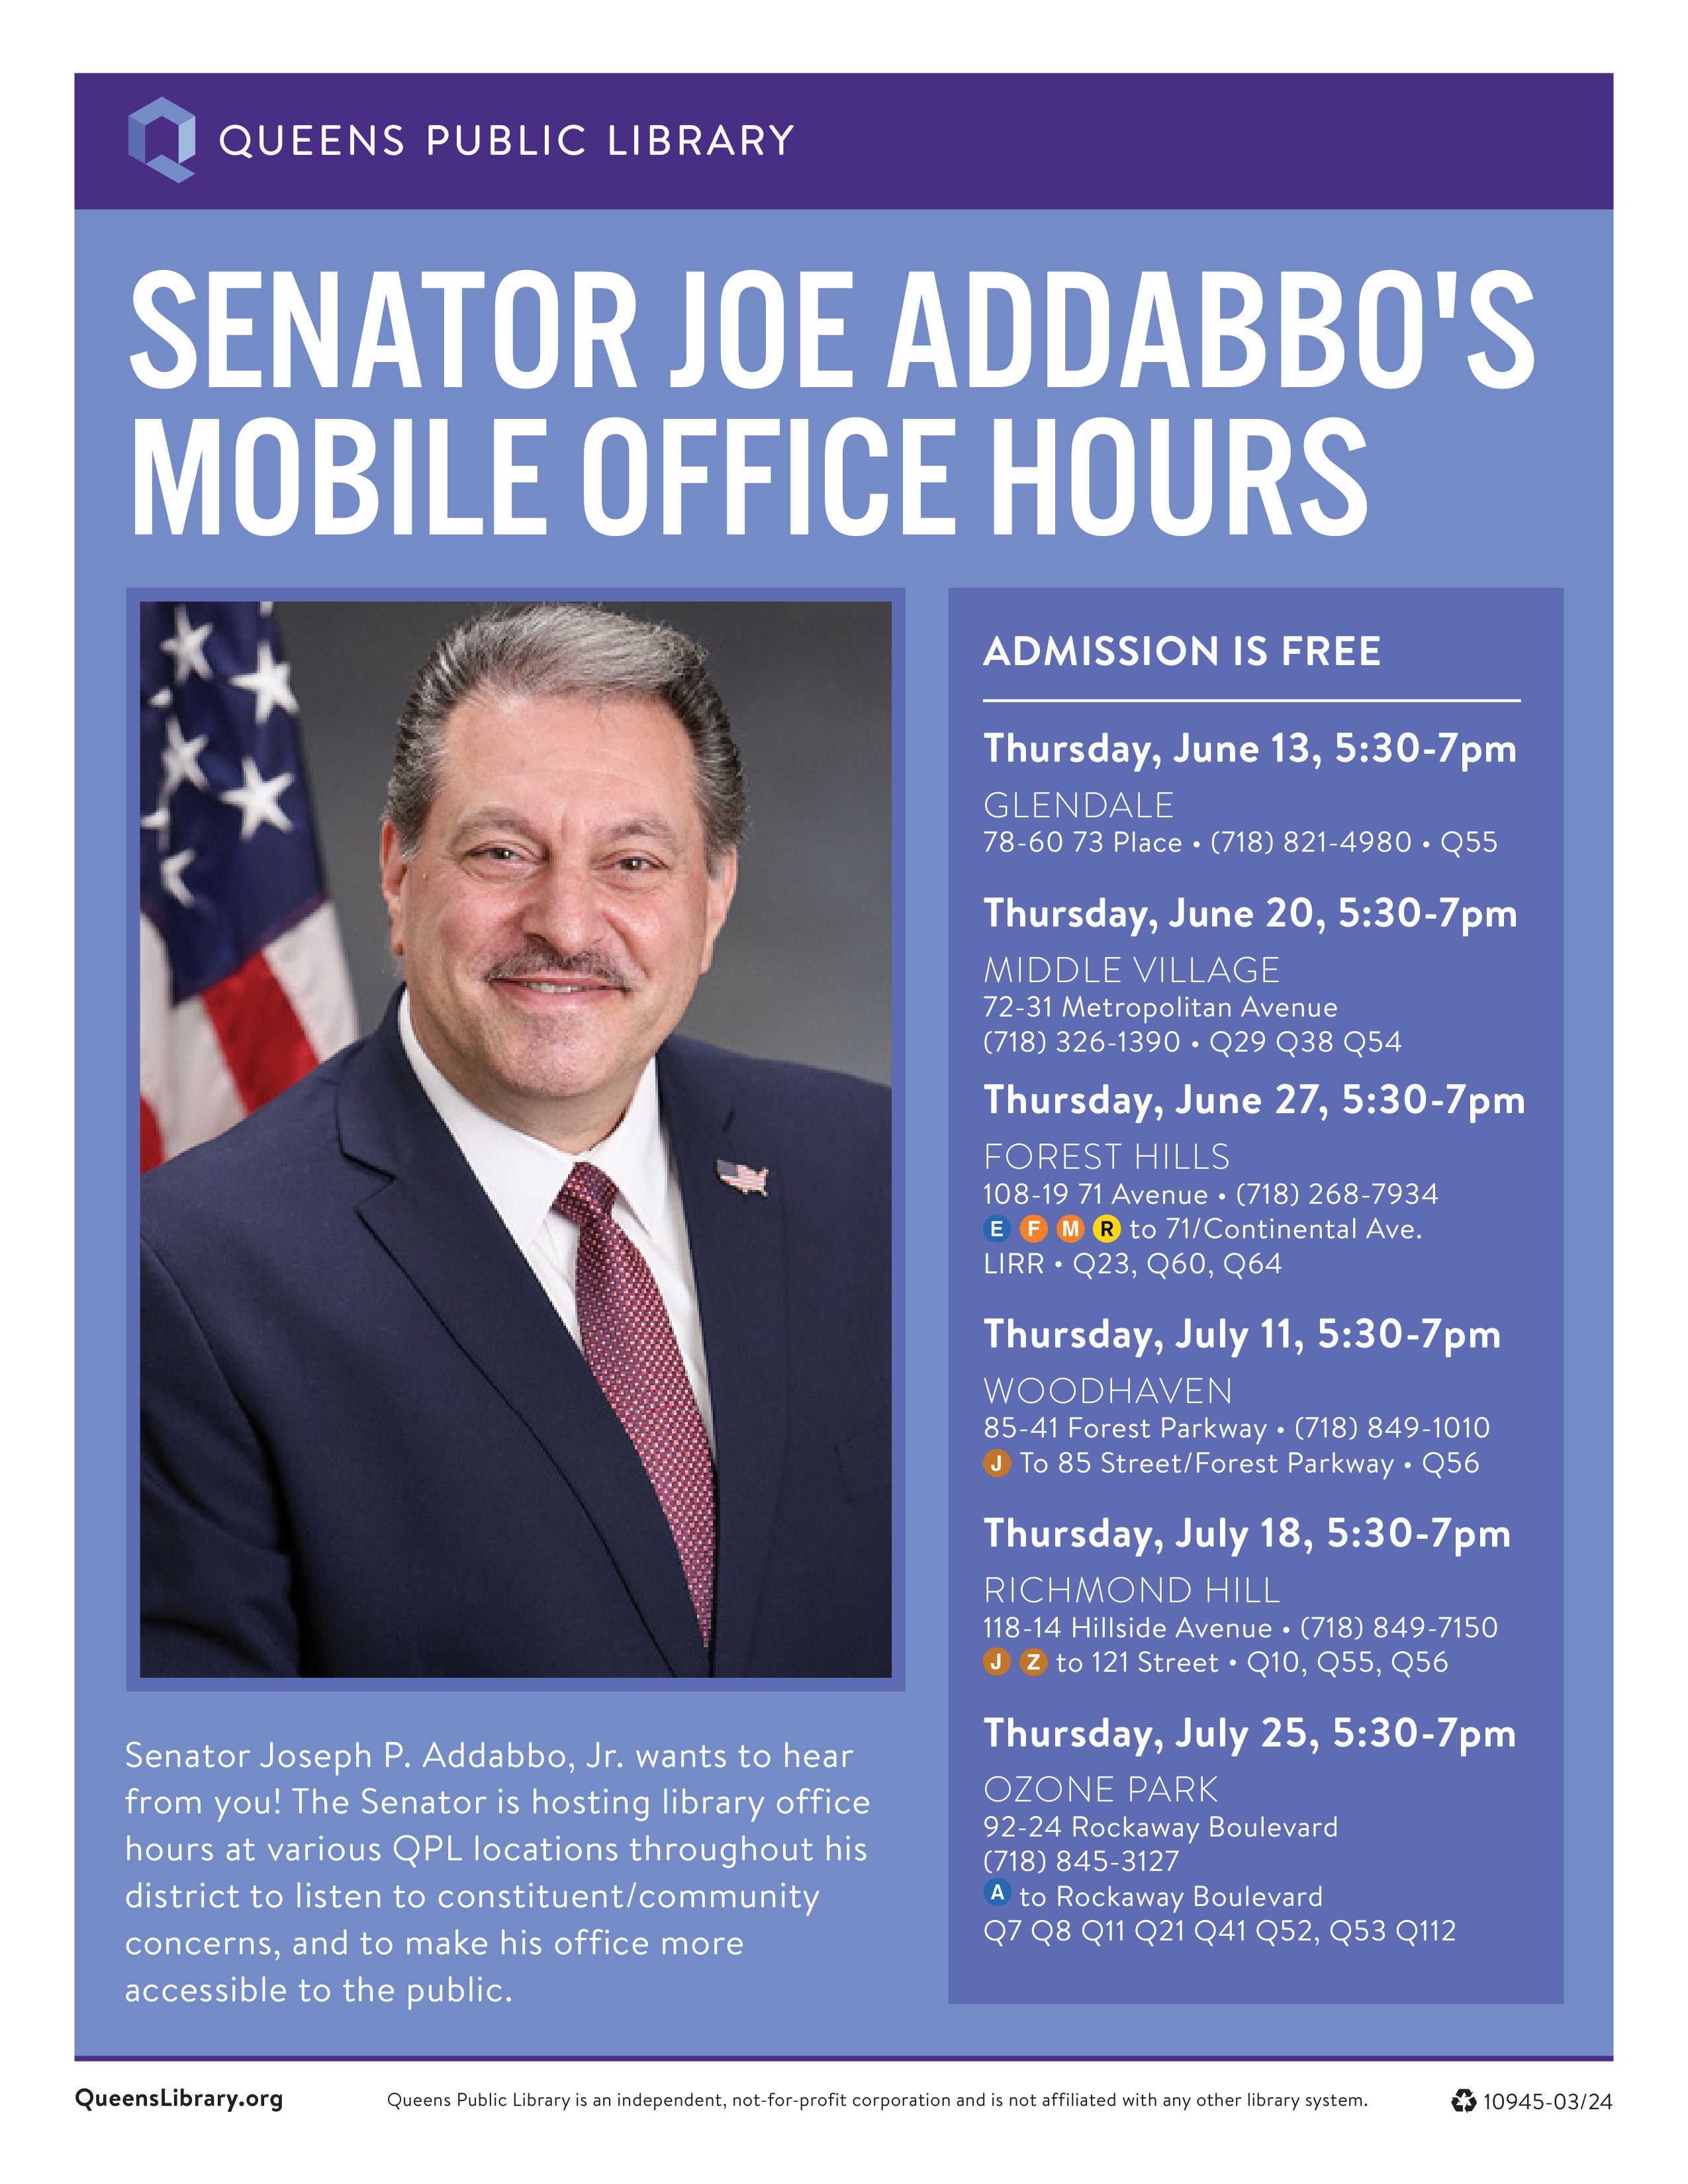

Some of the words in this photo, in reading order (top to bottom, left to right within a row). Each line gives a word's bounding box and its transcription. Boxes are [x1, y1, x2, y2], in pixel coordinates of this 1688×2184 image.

[219, 124, 404, 159] QUEENS
[428, 124, 585, 156] PUBLIC
[609, 124, 794, 156] LIBRARY
[129, 269, 638, 390] SENATOR
[670, 269, 853, 390] JOE
[886, 269, 1535, 390] ADDABBO'S
[134, 416, 547, 537] MOBILE
[583, 416, 956, 537] OFFICE
[993, 416, 1368, 537] HOURS
[982, 635, 1217, 666] ADMISSION
[1235, 635, 1268, 666] IS
[1283, 635, 1380, 666] FREE
[983, 732, 1161, 772] Thursday,
[1173, 732, 1259, 763] June
[1272, 731, 1321, 770] 13,
[1336, 731, 1516, 772] 5:30-7pm
[984, 791, 1174, 819] GLENDALE
[983, 831, 1063, 853] 78-60
[1073, 831, 1103, 853] 73
[1114, 831, 1182, 853] Place
[1211, 831, 1274, 854] (718)
[1284, 831, 1411, 853] 821-4980
[1441, 831, 1497, 858] Q55
[983, 897, 1158, 937] Thursday,
[1168, 897, 1254, 928] June
[1266, 897, 1325, 935] 20,
[1339, 896, 1517, 937] 5:30-7pm
[984, 956, 1121, 983] MIDDLE
[1133, 956, 1280, 983] VILLAGE
[983, 995, 1051, 1018] 72-31
[1062, 995, 1231, 1024] Metropolitan
[1241, 995, 1338, 1018] Avenue
[984, 1030, 1046, 1055] (718)
[1056, 1030, 1180, 1053] 326-1390
[1210, 1030, 1266, 1058] Q29
[1276, 1030, 1333, 1058] Q38
[1344, 1030, 1402, 1058] Q54
[983, 1083, 1163, 1124] Thursday,
[1175, 1083, 1262, 1115] June
[1276, 1083, 1328, 1122] 27,
[1343, 1083, 1524, 1124] 5:30-7pm
[986, 1142, 1122, 1170] FOREST
[1136, 1142, 1229, 1170] HILLS
[984, 1183, 1068, 1205] 108-19
[1078, 1183, 1101, 1205] 71
[1111, 1183, 1208, 1205] Avenue
[1237, 1183, 1299, 1206] (718)
[1309, 1183, 1439, 1205] 268-7934
[1129, 1220, 1156, 1240] to
[1166, 1217, 1356, 1240] 71/Continental
[1366, 1217, 1422, 1240] Ave.
[985, 1252, 1044, 1274] LIRR
[1073, 1252, 1137, 1280] Q23,
[1147, 1252, 1213, 1280] Q60,
[1223, 1252, 1282, 1280] Q64
[983, 1318, 1163, 1358] Thursday,
[1175, 1318, 1249, 1358] July
[1261, 1318, 1303, 1356] 11,
[1319, 1317, 1500, 1358] 5:30-7pm
[983, 1377, 1231, 1404] WOODHAVEN
[984, 1416, 1056, 1439] 85-41
[1069, 1416, 1151, 1439] Forest
[1161, 1416, 1268, 1445] Parkway
[1295, 1416, 1358, 1440] (718)
[1368, 1416, 1490, 1439] 849-1010
[1019, 1451, 1049, 1474] To
[1058, 1451, 1091, 1474] 85
[1101, 1451, 1278, 1474] Street/Forest
[1288, 1451, 1395, 1480] Parkway
[1423, 1451, 1479, 1479] Q56
[983, 1517, 1163, 1557] Thursday,
[1175, 1517, 1249, 1557] July
[1261, 1516, 1313, 1555] 18,
[1328, 1516, 1510, 1557] 5:30-7pm
[986, 1576, 1192, 1604] RICHMOND
[1207, 1576, 1280, 1603] HILL
[984, 1616, 1062, 1639] 118-14
[1072, 1616, 1166, 1639] Hillside
[1175, 1616, 1272, 1639] Avenue
[1301, 1616, 1363, 1640] (718)
[1374, 1616, 1498, 1639] 849-7150
[1056, 1653, 1083, 1673] to
[1092, 1651, 1127, 1672] 121
[1138, 1651, 1219, 1673] Street
[1247, 1651, 1307, 1678] Q10,
[1317, 1651, 1382, 1678] Q55,
[1391, 1651, 1448, 1678] Q56
[983, 1717, 1163, 1757] Thursday,
[1175, 1717, 1249, 1757] July
[1261, 1716, 1319, 1755] 25,
[1334, 1716, 1515, 1757] 5:30-7pm
[126, 1741, 251, 1768] Senator
[259, 1741, 371, 1776] Joseph
[385, 1741, 410, 1768] P.
[422, 1741, 575, 1774] Addabbo,
[586, 1741, 623, 1768] Jr.
[635, 1745, 727, 1768] wants
[737, 1745, 771, 1768] to
[784, 1741, 854, 1768] hear
[124, 1787, 201, 1815] from
[214, 1788, 280, 1823] you!
[291, 1788, 349, 1815] The
[361, 1787, 487, 1815] Senator
[498, 1788, 520, 1815] is
[533, 1788, 649, 1822] hosting
[663, 1788, 765, 1823] library
[776, 1787, 870, 1815] office
[984, 1815, 1062, 1838] 92-24
[1072, 1815, 1200, 1844] Rockaway
[1209, 1815, 1337, 1838] Boulevard
[126, 1835, 214, 1862] hours
[226, 1838, 256, 1862] at
[267, 1835, 381, 1862] various
[393, 1834, 463, 1868] QPL
[475, 1835, 618, 1862] locations
[629, 1835, 814, 1869] throughout
[826, 1835, 867, 1862] his
[984, 1850, 1046, 1874] (718)
[1056, 1850, 1180, 1872] 845-3127
[984, 1919, 1022, 1947] Q7
[1031, 1919, 1071, 1947] Q8
[1082, 1919, 1123, 1947] Q11
[1135, 1919, 1183, 1947] Q21
[1194, 1919, 1244, 1947] Q41
[1256, 1919, 1319, 1947] Q52,
[1330, 1919, 1385, 1947] Q53
[1396, 1919, 1456, 1947] Q112
[125, 1976, 287, 2003] accessible
[298, 1979, 331, 2003] to
[342, 1976, 395, 2003] the
[408, 1976, 512, 2011] public.
[75, 2087, 283, 2113] QueensLibrary.org
[387, 2092, 451, 2111] Queens
[457, 2092, 507, 2107] Public
[514, 2092, 571, 2111] Library
[576, 2093, 587, 2107] is
[593, 2097, 611, 2107] an
[618, 2092, 727, 2111] independent,
[733, 2092, 847, 2111] not-for-profit
[852, 2093, 951, 2111] corporation
[957, 2092, 985, 2107] and
[992, 2093, 1003, 2107] is
[1009, 2094, 1037, 2107] not
[1042, 2092, 1116, 2107] affiliated
[1122, 2092, 1157, 2107] with
[1163, 2097, 1192, 2111] any
[1196, 2092, 1242, 2107] other
[1248, 2092, 1300, 2111] library
[1305, 2094, 1368, 2111] system.
[1484, 2093, 1613, 2111] 10945-03/24
